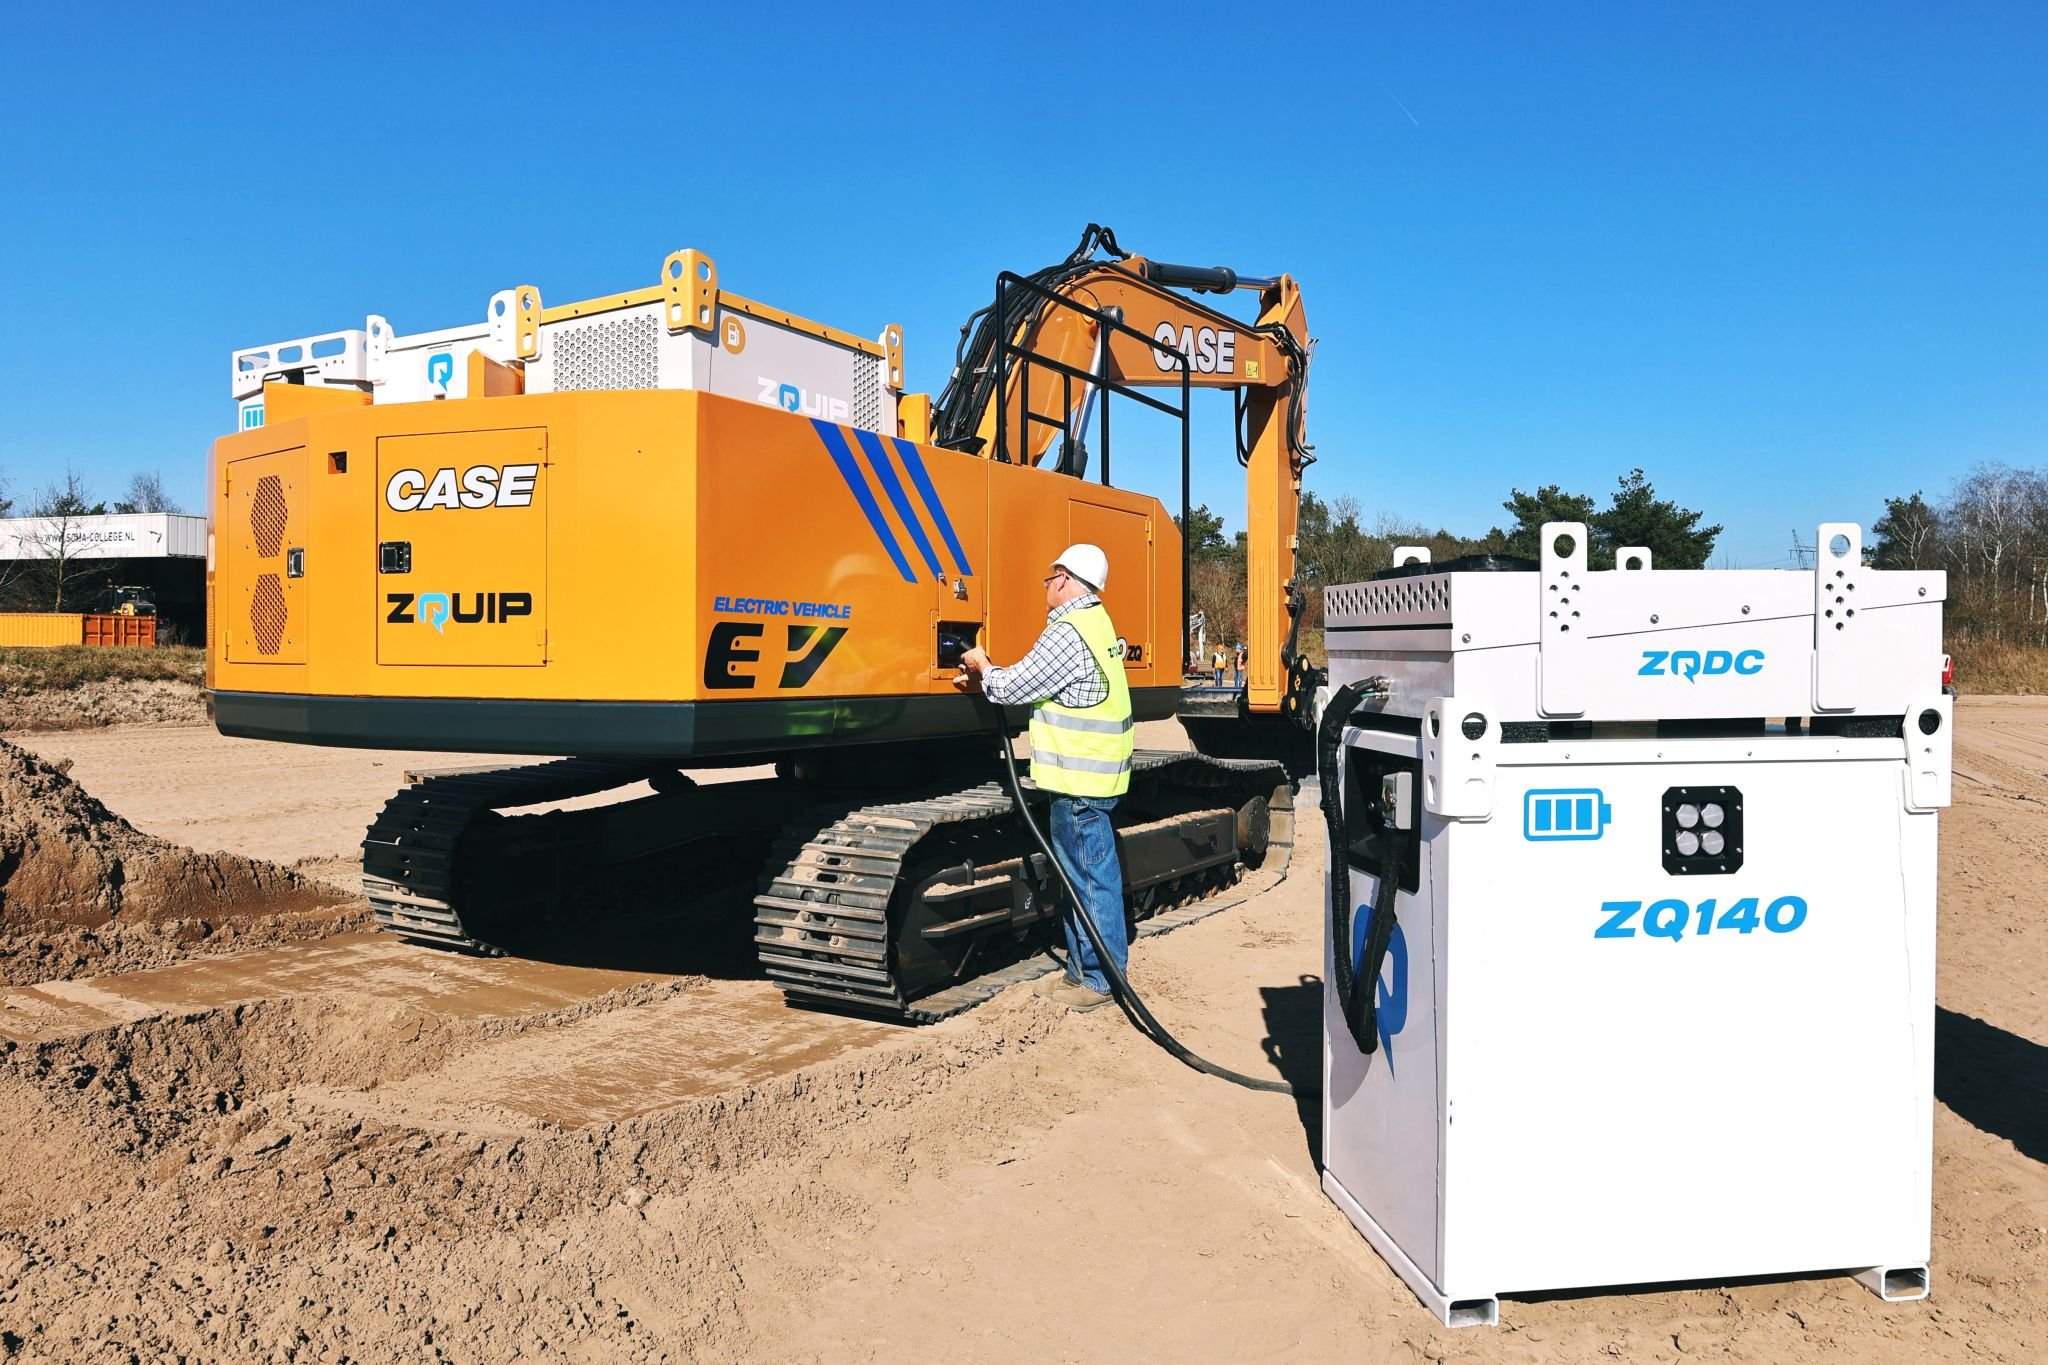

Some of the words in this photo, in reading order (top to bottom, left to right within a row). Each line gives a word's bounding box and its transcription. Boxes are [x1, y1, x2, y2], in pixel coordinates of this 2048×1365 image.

[1153, 321, 1235, 374] CASE
[757, 376, 849, 420] ZQUIP
[386, 464, 539, 512] CASE
[387, 592, 532, 634] ZQUIP
[714, 596, 789, 616] ELECTRIC
[792, 602, 851, 619] VEHICLE
[1638, 649, 1765, 684] ZQDC
[1594, 896, 1808, 943] ZQ140
